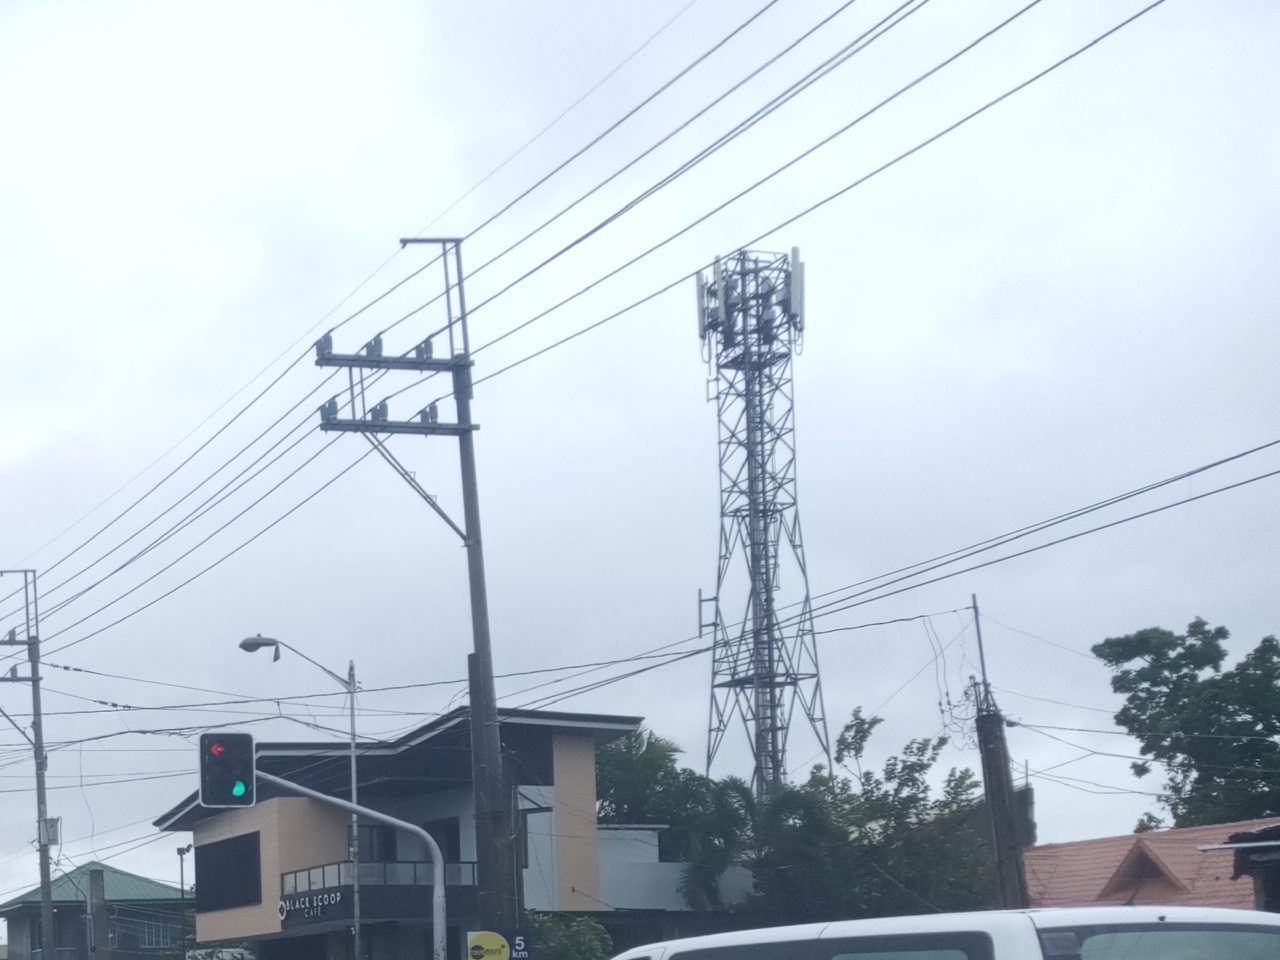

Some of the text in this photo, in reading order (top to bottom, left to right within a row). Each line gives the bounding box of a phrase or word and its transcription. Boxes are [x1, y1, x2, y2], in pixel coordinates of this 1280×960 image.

[286, 892, 341, 911] BLACK SCOOP
[515, 936, 525, 950] 5
[512, 950, 528, 958] km
